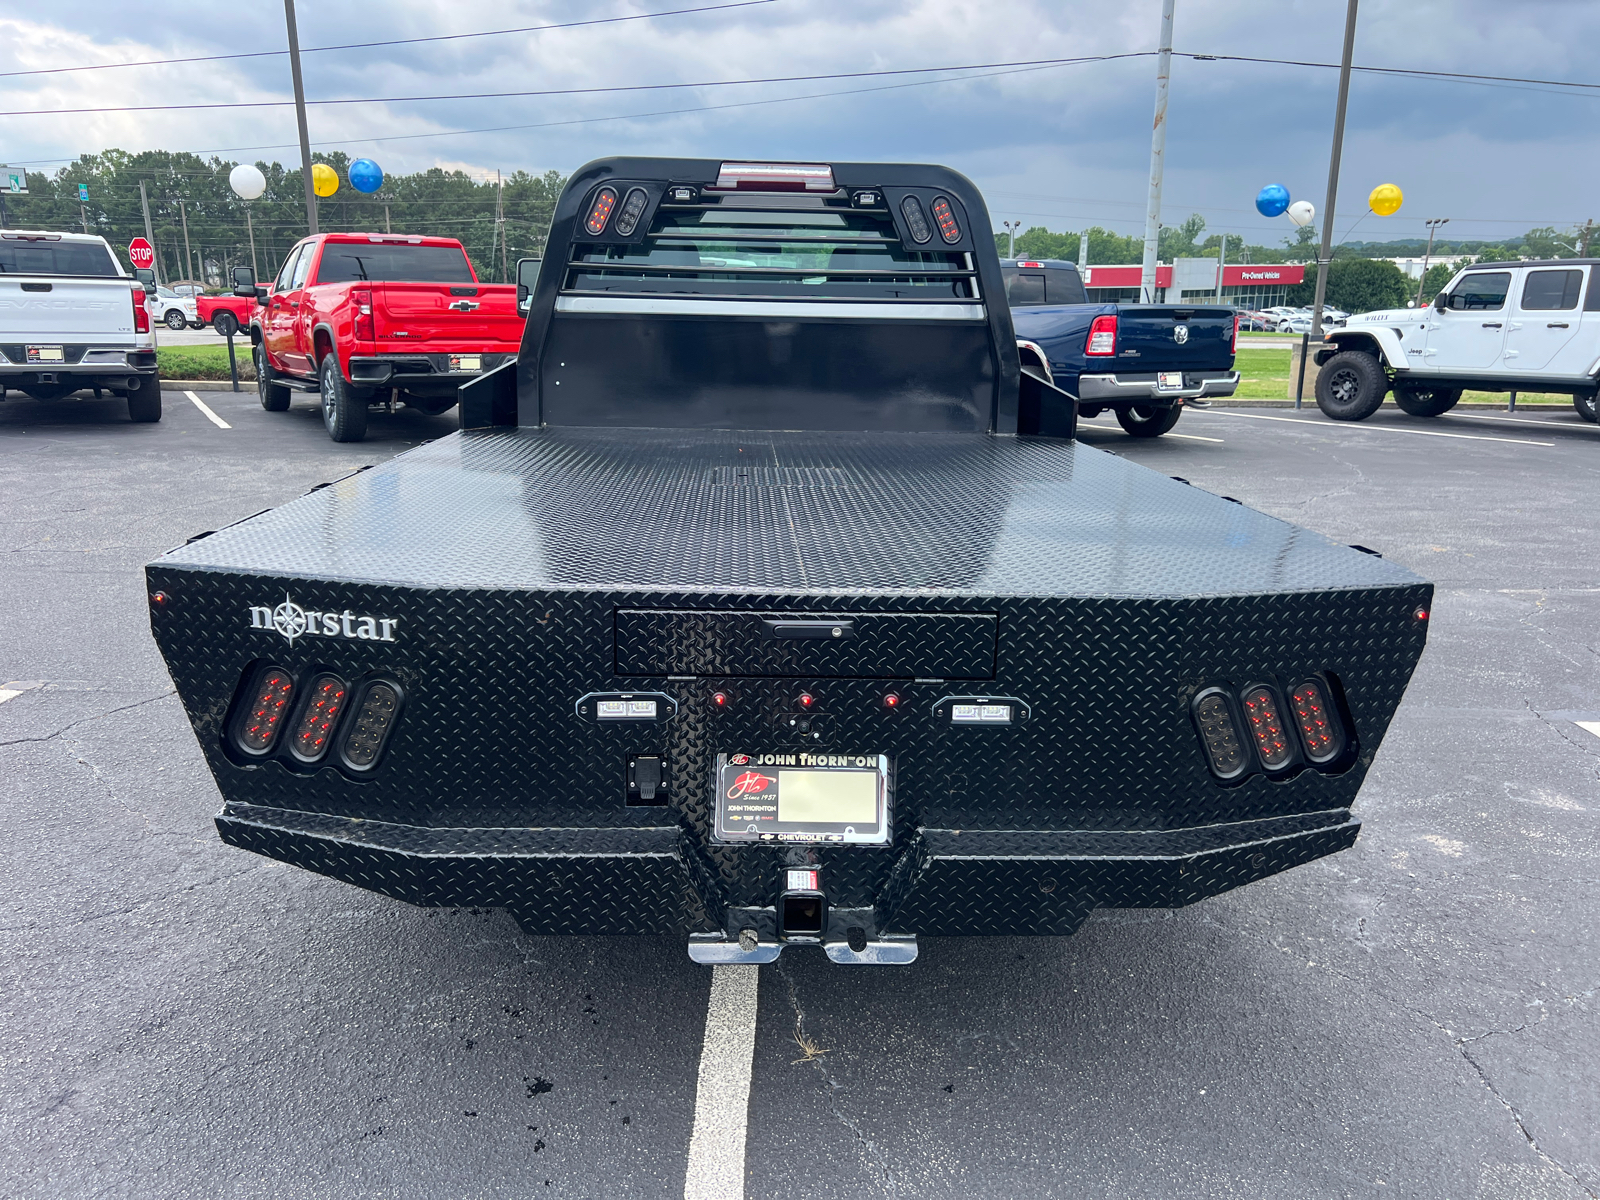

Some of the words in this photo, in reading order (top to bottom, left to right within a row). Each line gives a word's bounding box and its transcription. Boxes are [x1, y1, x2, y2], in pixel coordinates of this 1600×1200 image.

[131, 248, 151, 260] STOP
[1241, 271, 1264, 280] Pre-Owned
[1264, 271, 1280, 279] Vehicles
[757, 754, 796, 765] JOHN
[777, 834, 826, 842] CHEVROLET
